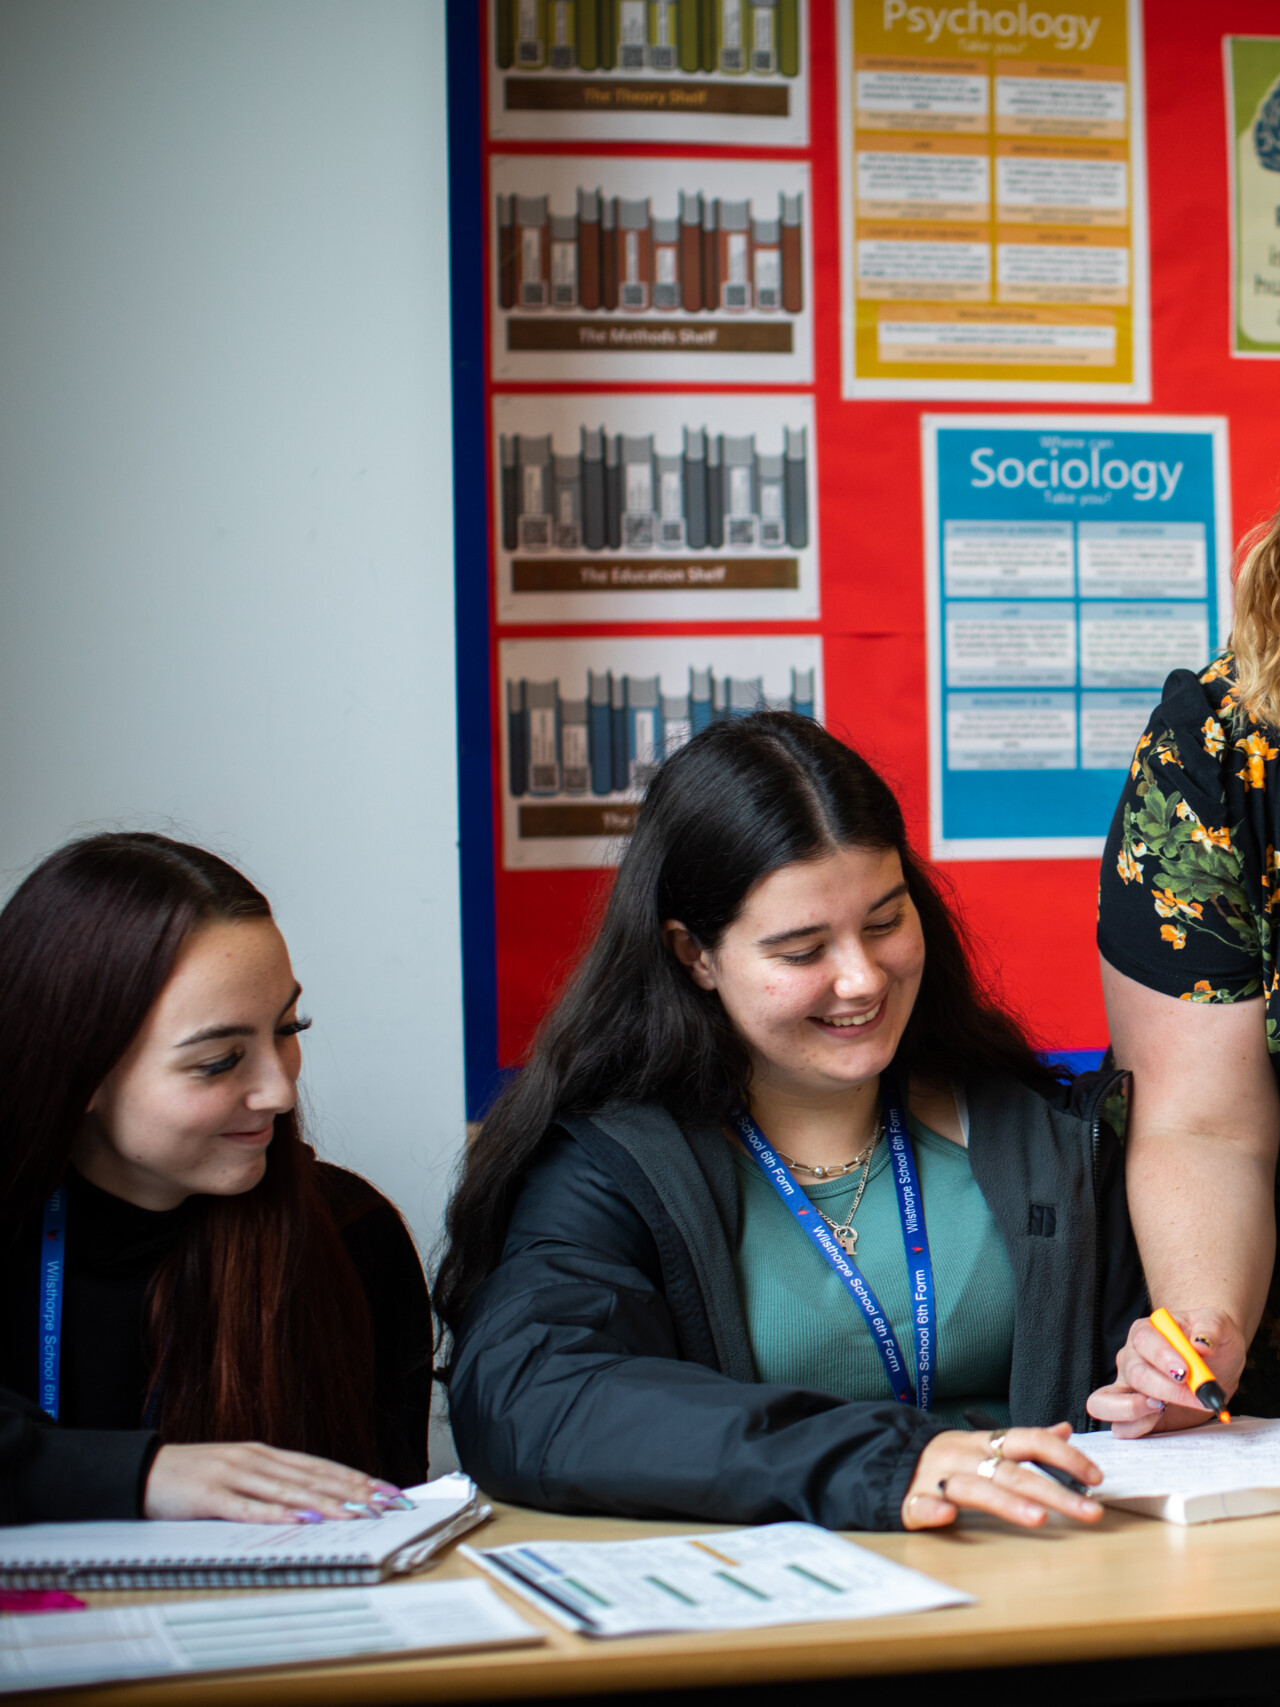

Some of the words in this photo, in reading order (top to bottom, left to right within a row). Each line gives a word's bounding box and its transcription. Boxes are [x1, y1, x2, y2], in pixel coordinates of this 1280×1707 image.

[883, 0, 1100, 50] Psychology
[578, 327, 606, 343] The
[610, 328, 677, 345] Methods
[679, 329, 717, 346] Shelf
[970, 447, 1183, 501] Sociology
[580, 567, 606, 583] The
[611, 567, 685, 583] Education
[687, 566, 726, 582] Shelf
[889, 1108, 899, 1132] Form
[737, 1116, 767, 1152] School
[760, 1150, 777, 1169] 6th
[771, 1167, 795, 1196] Form
[891, 1133, 905, 1152] 6th
[897, 1154, 911, 1184] School
[903, 1186, 919, 1234] Wilsthorpe
[42, 1260, 60, 1331] Wilsthorpe
[812, 1225, 853, 1278] Wilsthorpe
[850, 1278, 877, 1317] School
[873, 1317, 888, 1338] 6th
[882, 1338, 901, 1373] Form
[915, 1269, 927, 1301] Form
[916, 1304, 929, 1324] 6th
[44, 1335, 57, 1380] School
[919, 1326, 930, 1371] School
[44, 1384, 56, 1405] 6th
